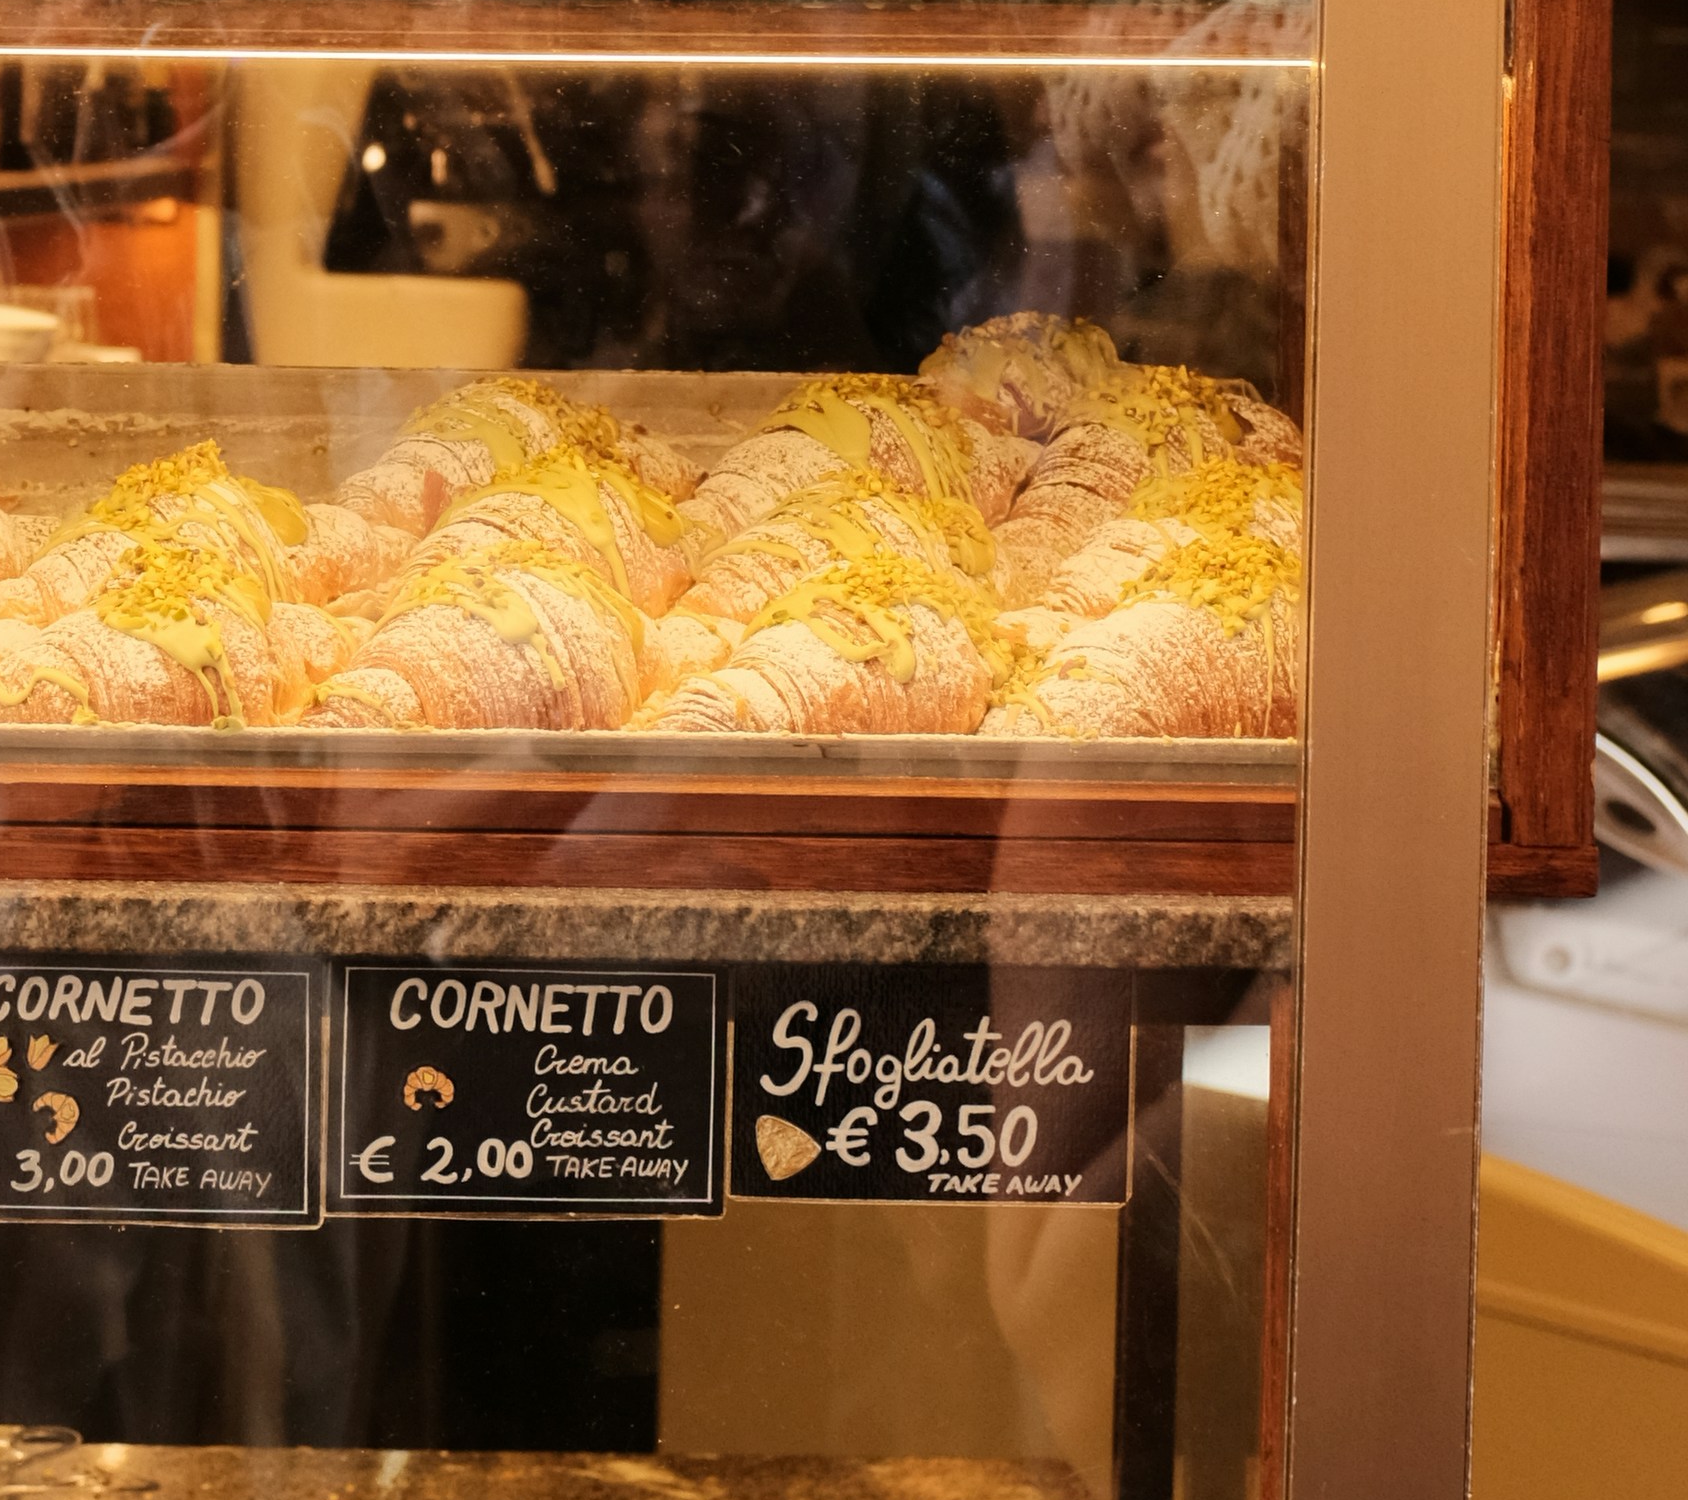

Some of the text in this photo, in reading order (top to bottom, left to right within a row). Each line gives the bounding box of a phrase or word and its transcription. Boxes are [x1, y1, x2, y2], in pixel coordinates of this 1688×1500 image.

[389, 977, 674, 1037] CORNETTO
[62, 1031, 267, 1071] al Pistacchio
[534, 1043, 639, 1076] Crema
[759, 1000, 1095, 1110] Sfogliatella
[106, 1075, 247, 1108] Pistachio
[525, 1078, 663, 1119] Custard
[117, 1120, 259, 1153] Croissant
[530, 1117, 675, 1150] Croissant
[128, 1161, 272, 1198] TAKE AWAY
[545, 1154, 689, 1185] TAKE AWAY
[927, 1172, 1083, 1197] TAKE AWAY
